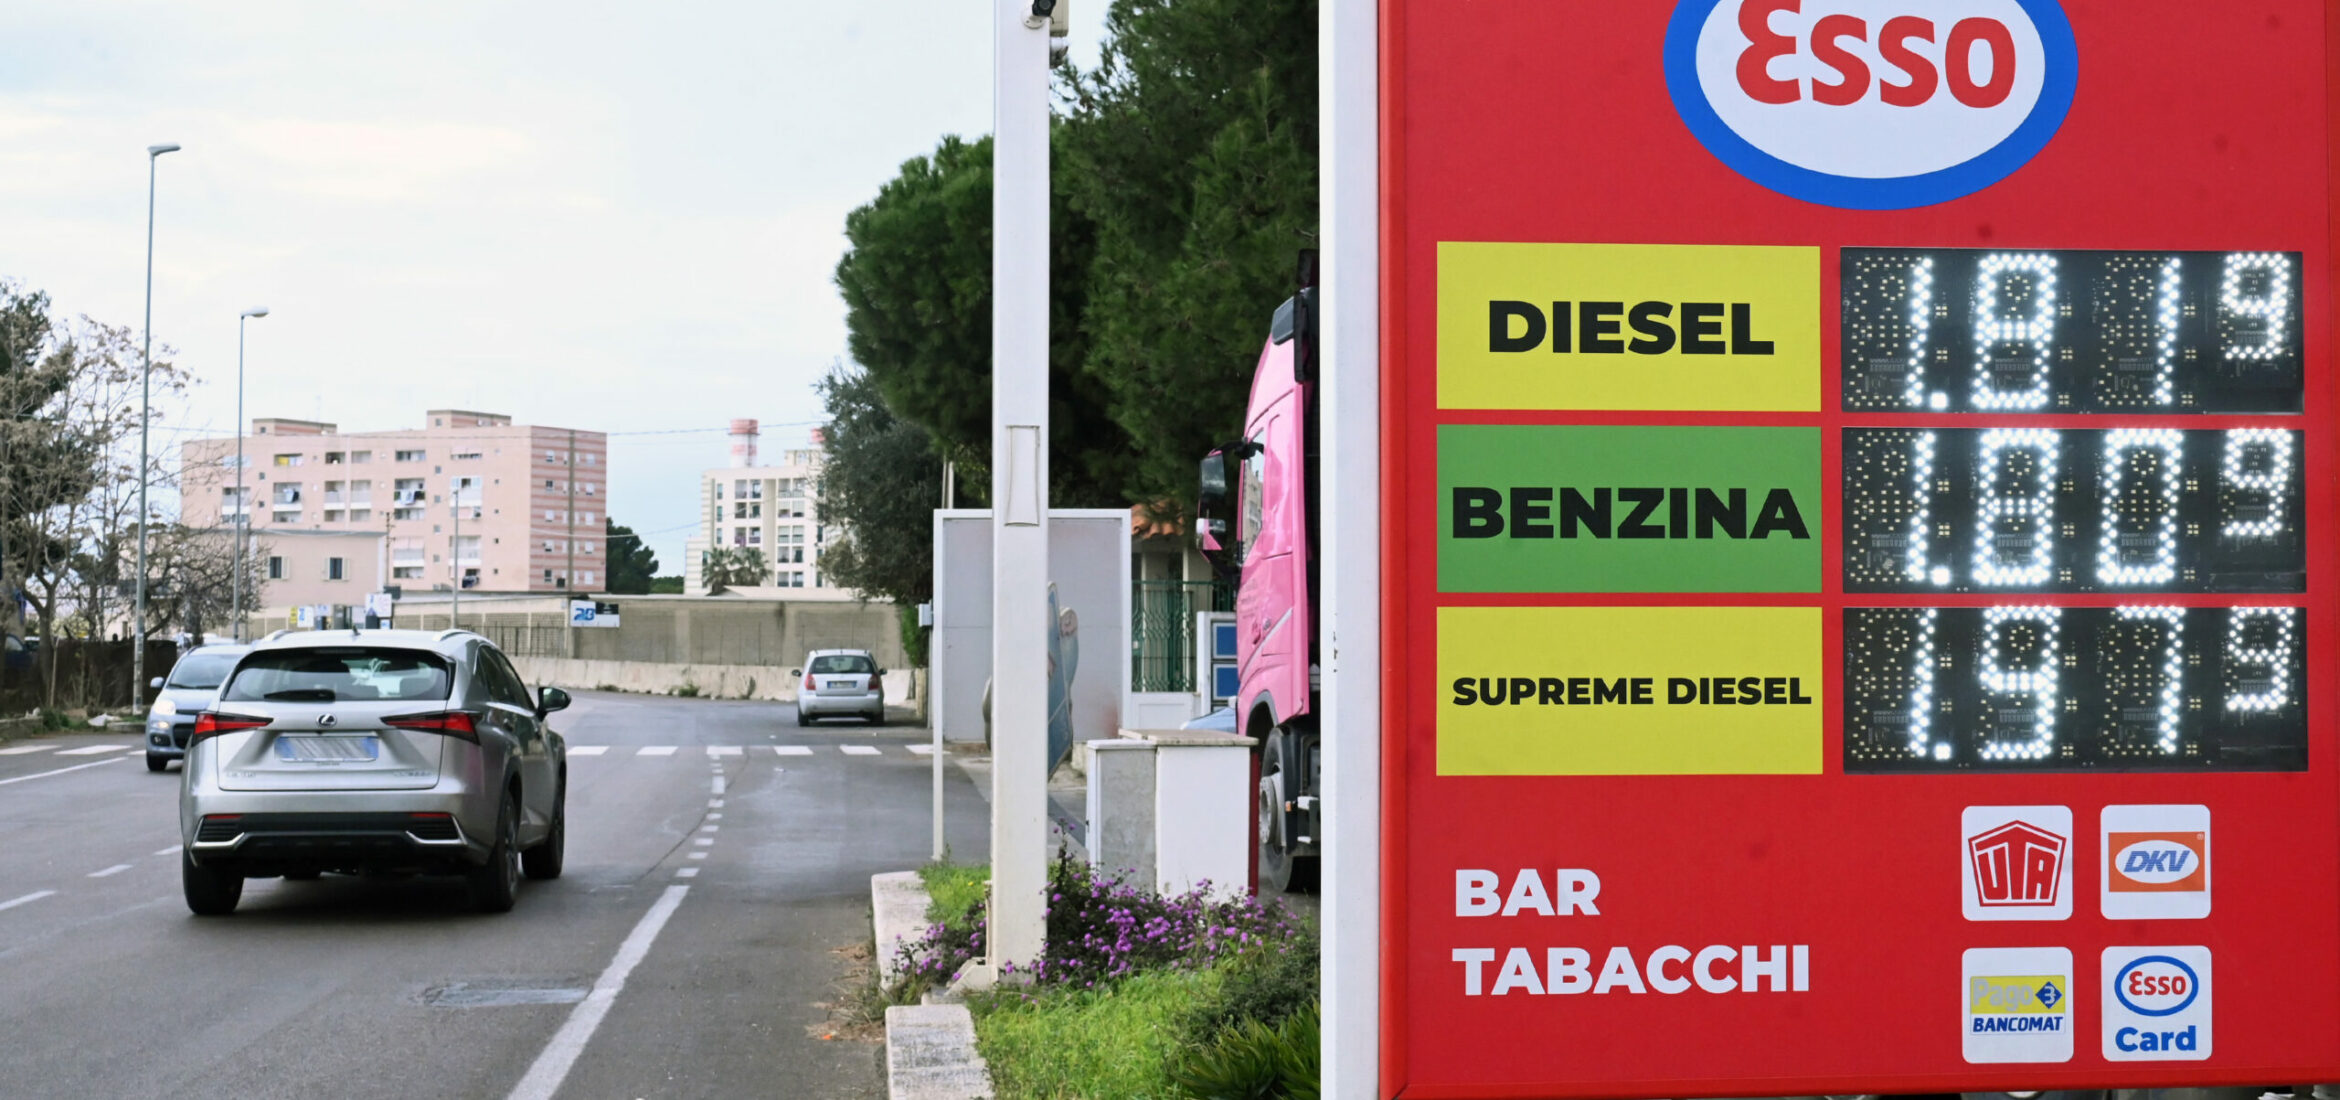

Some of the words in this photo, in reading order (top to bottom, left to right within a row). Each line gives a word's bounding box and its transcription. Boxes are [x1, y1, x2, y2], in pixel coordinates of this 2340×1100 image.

[1489, 300, 1775, 355] DIESEL
[1452, 486, 1811, 540] BENZINA
[1452, 677, 1654, 706] SUPREME
[1667, 677, 1812, 706] DIESEL
[1975, 826, 2060, 900] UTA
[2123, 850, 2191, 873] DKV
[1455, 868, 1601, 917] BAR
[1451, 944, 1809, 996] TABACCHI
[1973, 978, 2033, 1011] Pago
[1972, 1016, 2064, 1033] BANCOMAT
[2115, 1025, 2198, 1053] Card
